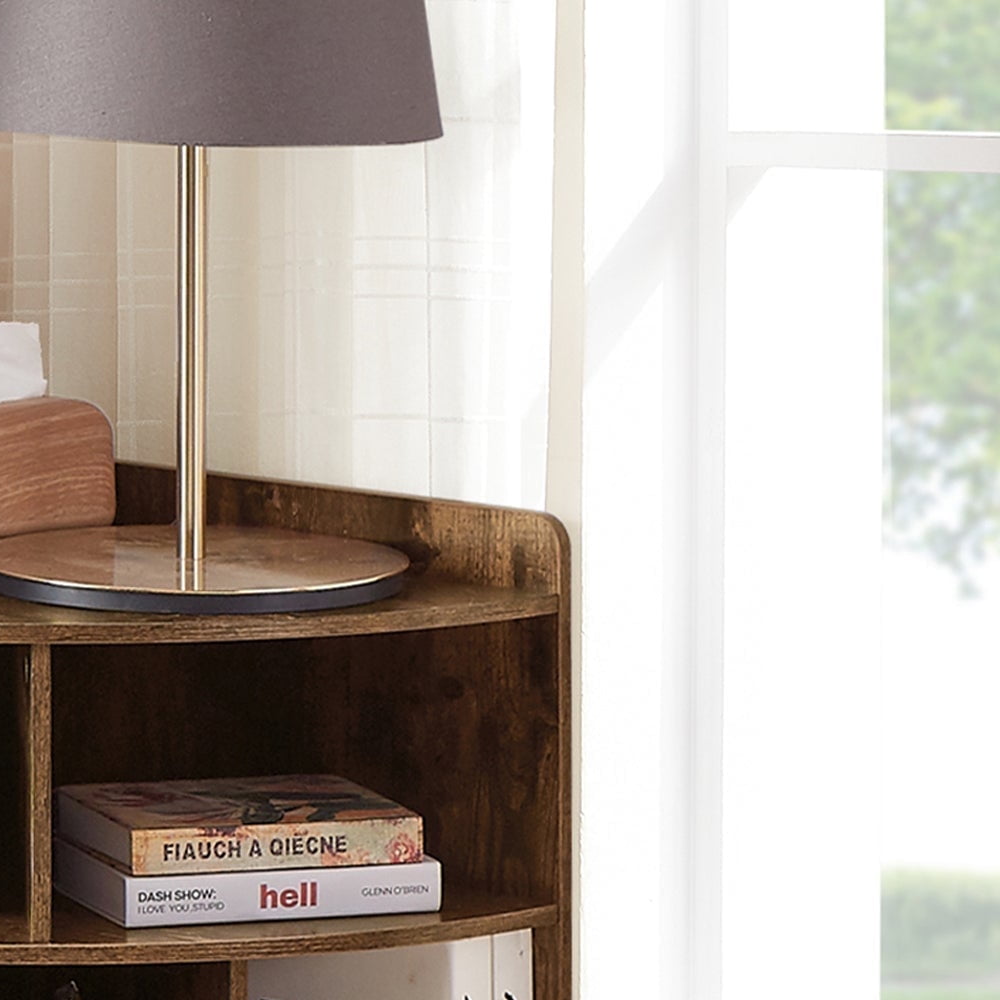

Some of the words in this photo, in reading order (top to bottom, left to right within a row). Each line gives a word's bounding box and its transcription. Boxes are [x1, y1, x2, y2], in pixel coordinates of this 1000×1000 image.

[163, 840, 241, 862] FIAUCH
[249, 838, 262, 857] A
[137, 890, 172, 903] DASH
[174, 887, 217, 901] SHOW:
[259, 881, 318, 909] hell
[361, 885, 393, 897] GLENN
[393, 884, 430, 896] O'BRIEN
[142, 903, 166, 915] LOVE
[168, 902, 190, 913] YOU
